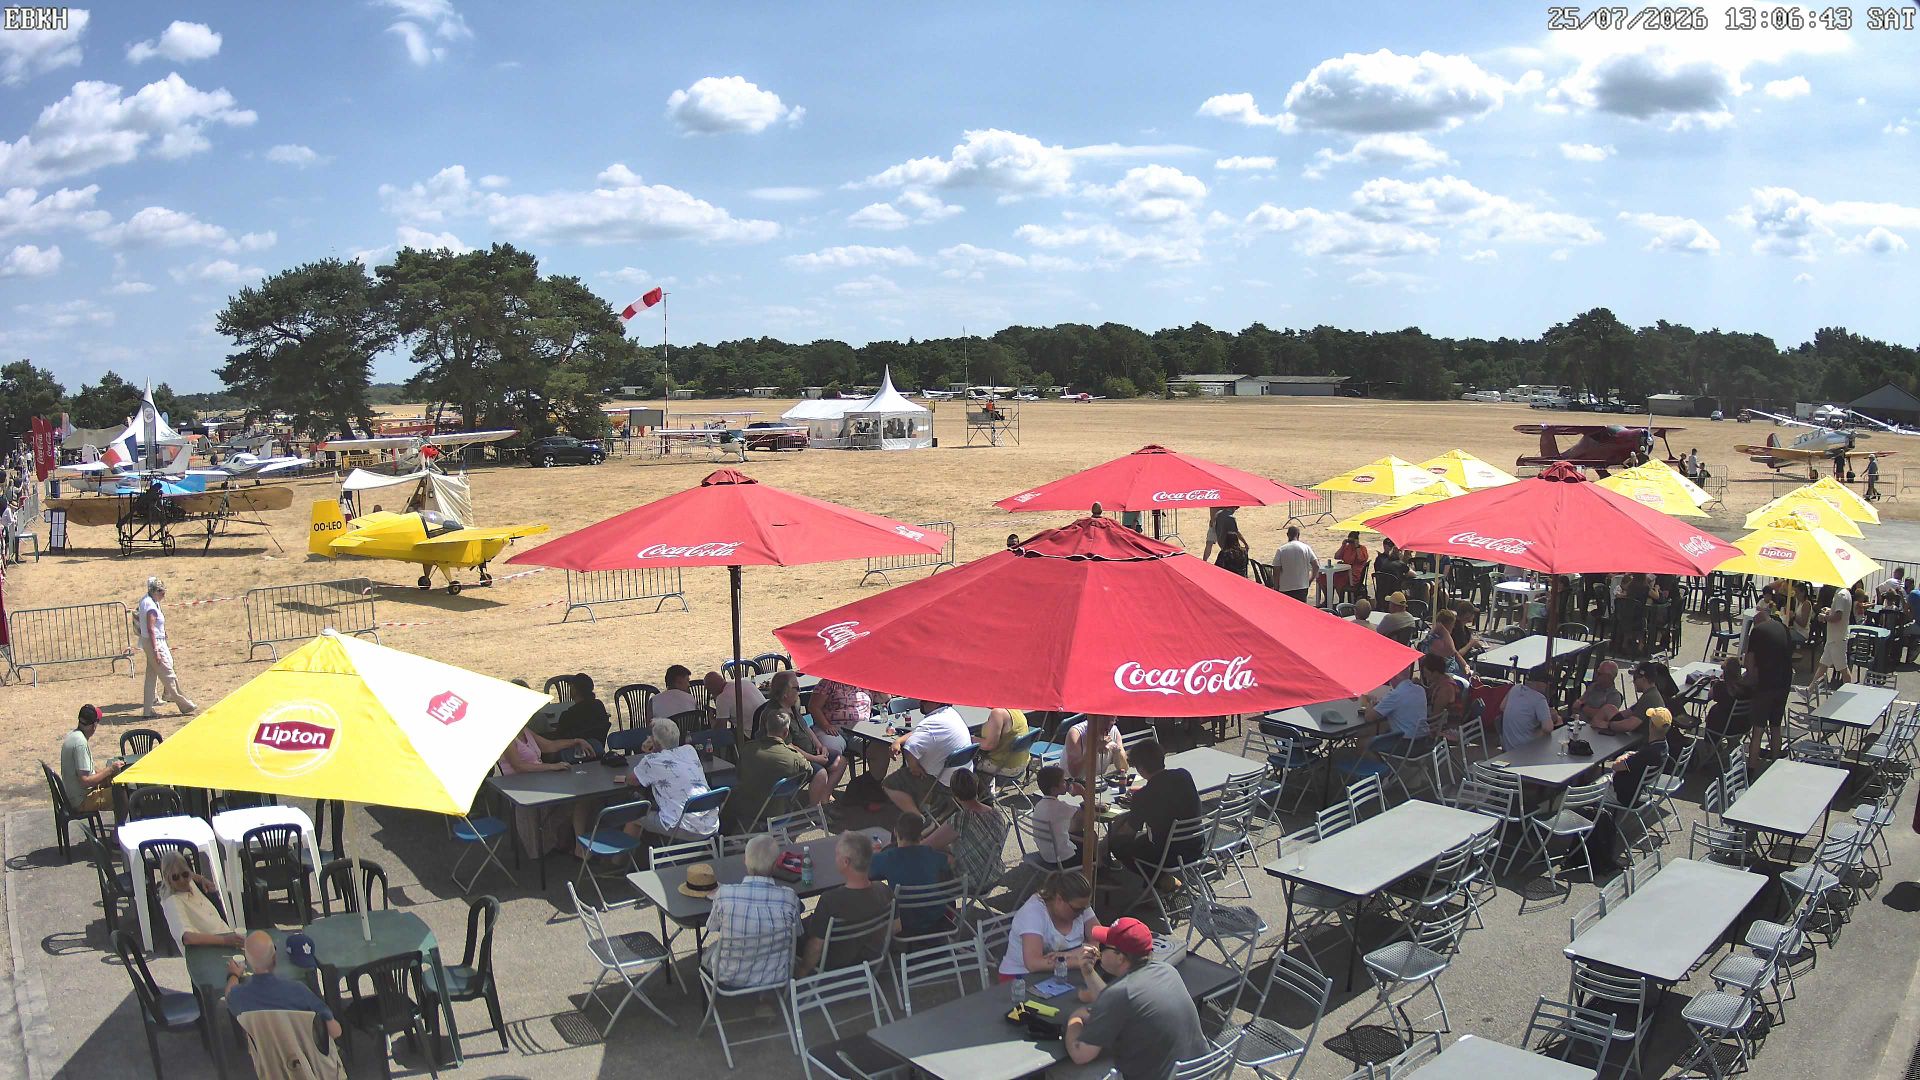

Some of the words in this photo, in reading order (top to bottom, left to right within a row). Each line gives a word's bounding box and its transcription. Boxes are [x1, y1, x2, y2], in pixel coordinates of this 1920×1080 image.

[1152, 489, 1221, 502] Coca-Cola
[313, 520, 342, 531] OO-LEO
[637, 541, 744, 559] Coca-Cola
[1761, 547, 1793, 559] Lipton
[1114, 654, 1257, 695] Coca-Cola
[431, 693, 464, 721] Lipton
[260, 725, 326, 745] Lipton
